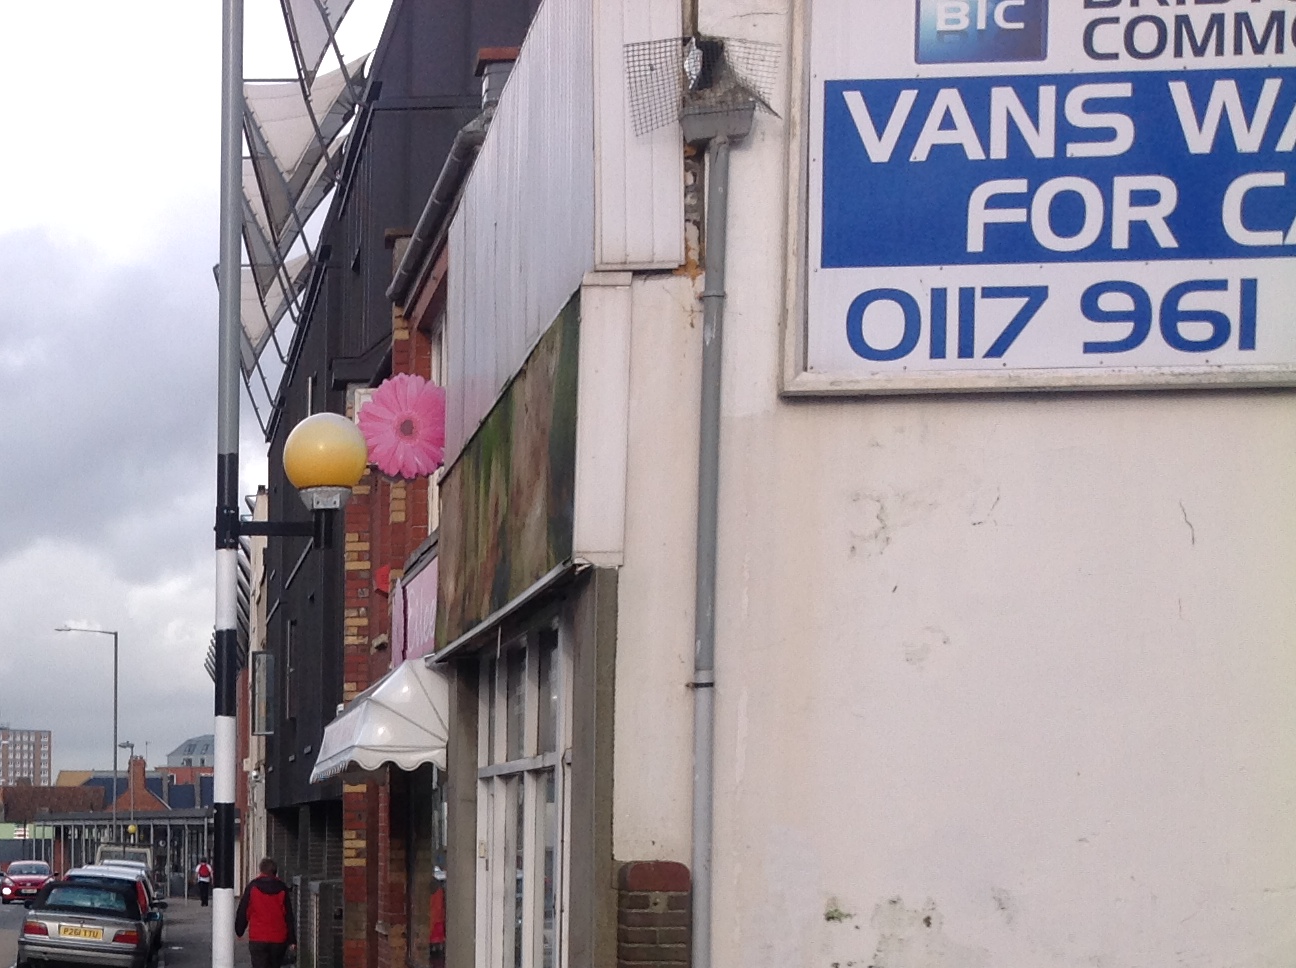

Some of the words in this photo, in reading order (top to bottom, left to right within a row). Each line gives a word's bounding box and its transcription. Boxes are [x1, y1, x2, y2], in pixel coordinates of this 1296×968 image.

[1083, 10, 1296, 60] COMM
[842, 83, 1135, 163] VANS
[1168, 77, 1296, 155] W
[966, 175, 1179, 253] FOR
[1222, 171, 1296, 246] C
[846, 285, 1049, 362] 0117
[1080, 278, 1258, 354] 961
